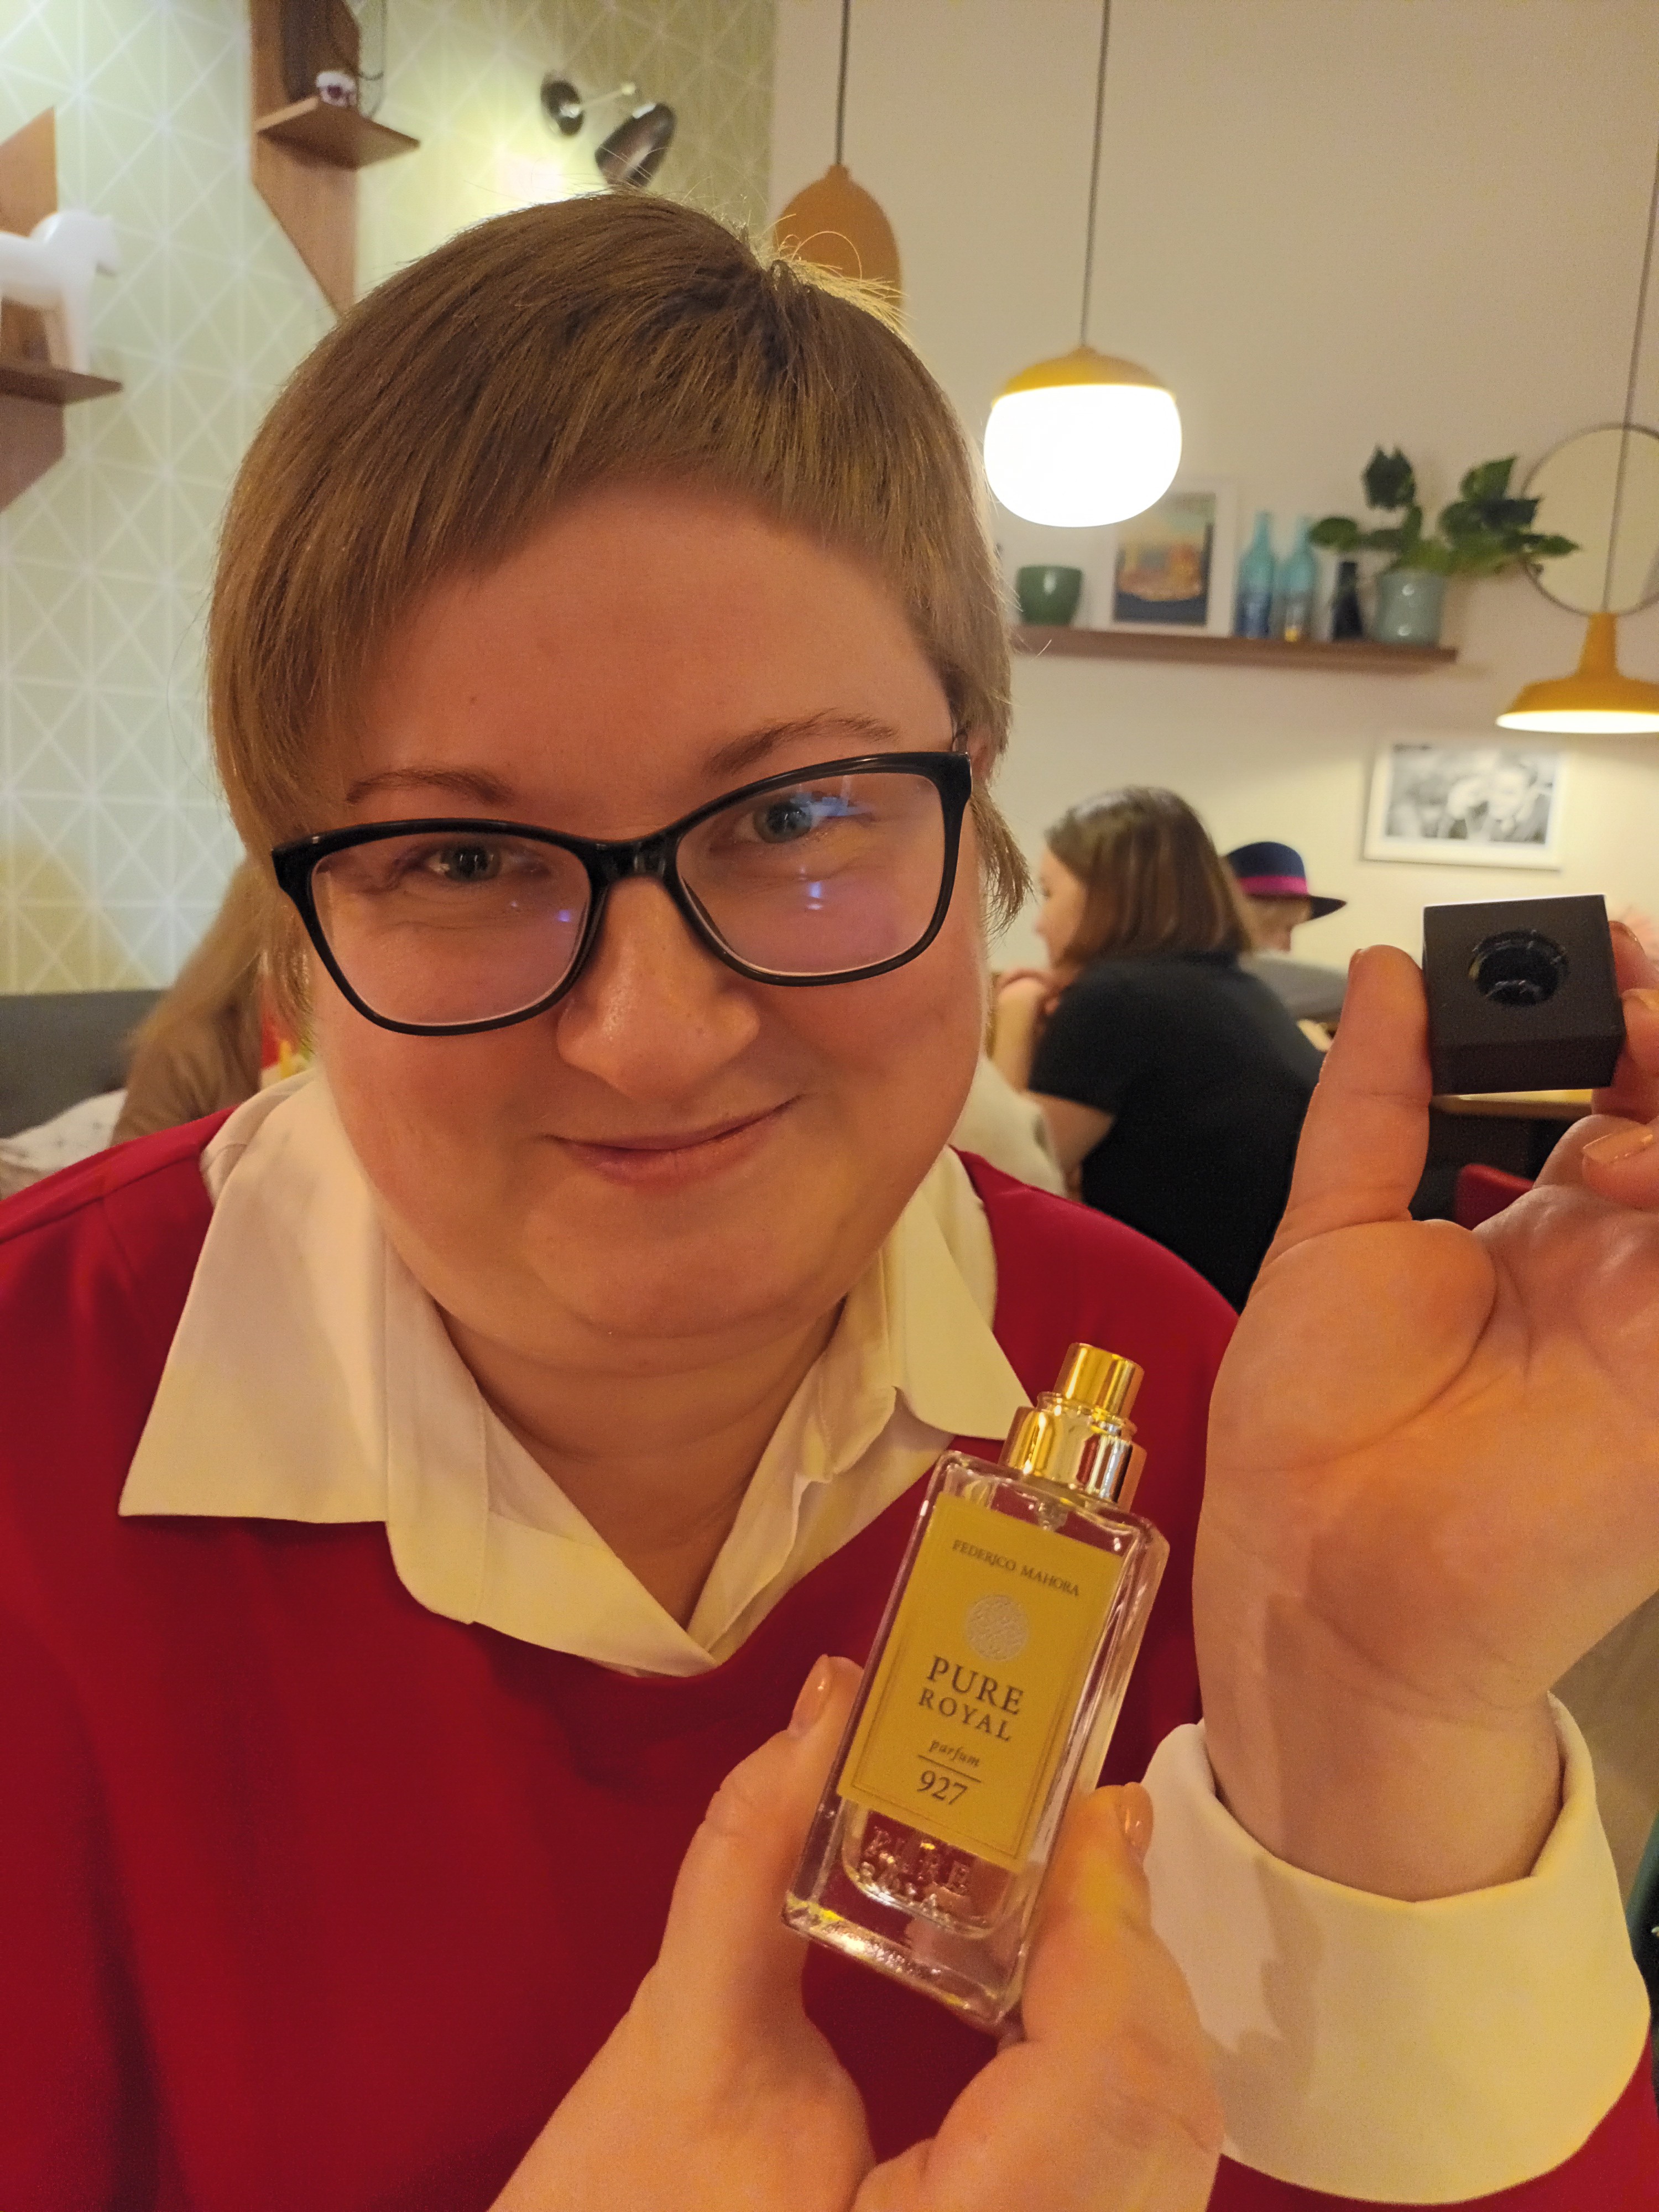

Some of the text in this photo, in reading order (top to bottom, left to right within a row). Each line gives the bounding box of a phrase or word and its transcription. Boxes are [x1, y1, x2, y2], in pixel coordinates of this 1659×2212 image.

[952, 1539, 1079, 1597] FEDERICO MAHORA
[926, 1654, 1024, 1715] PURE
[918, 1687, 1011, 1741] ROYAL
[928, 1740, 980, 1767] parfum
[916, 1770, 968, 1805] 927
